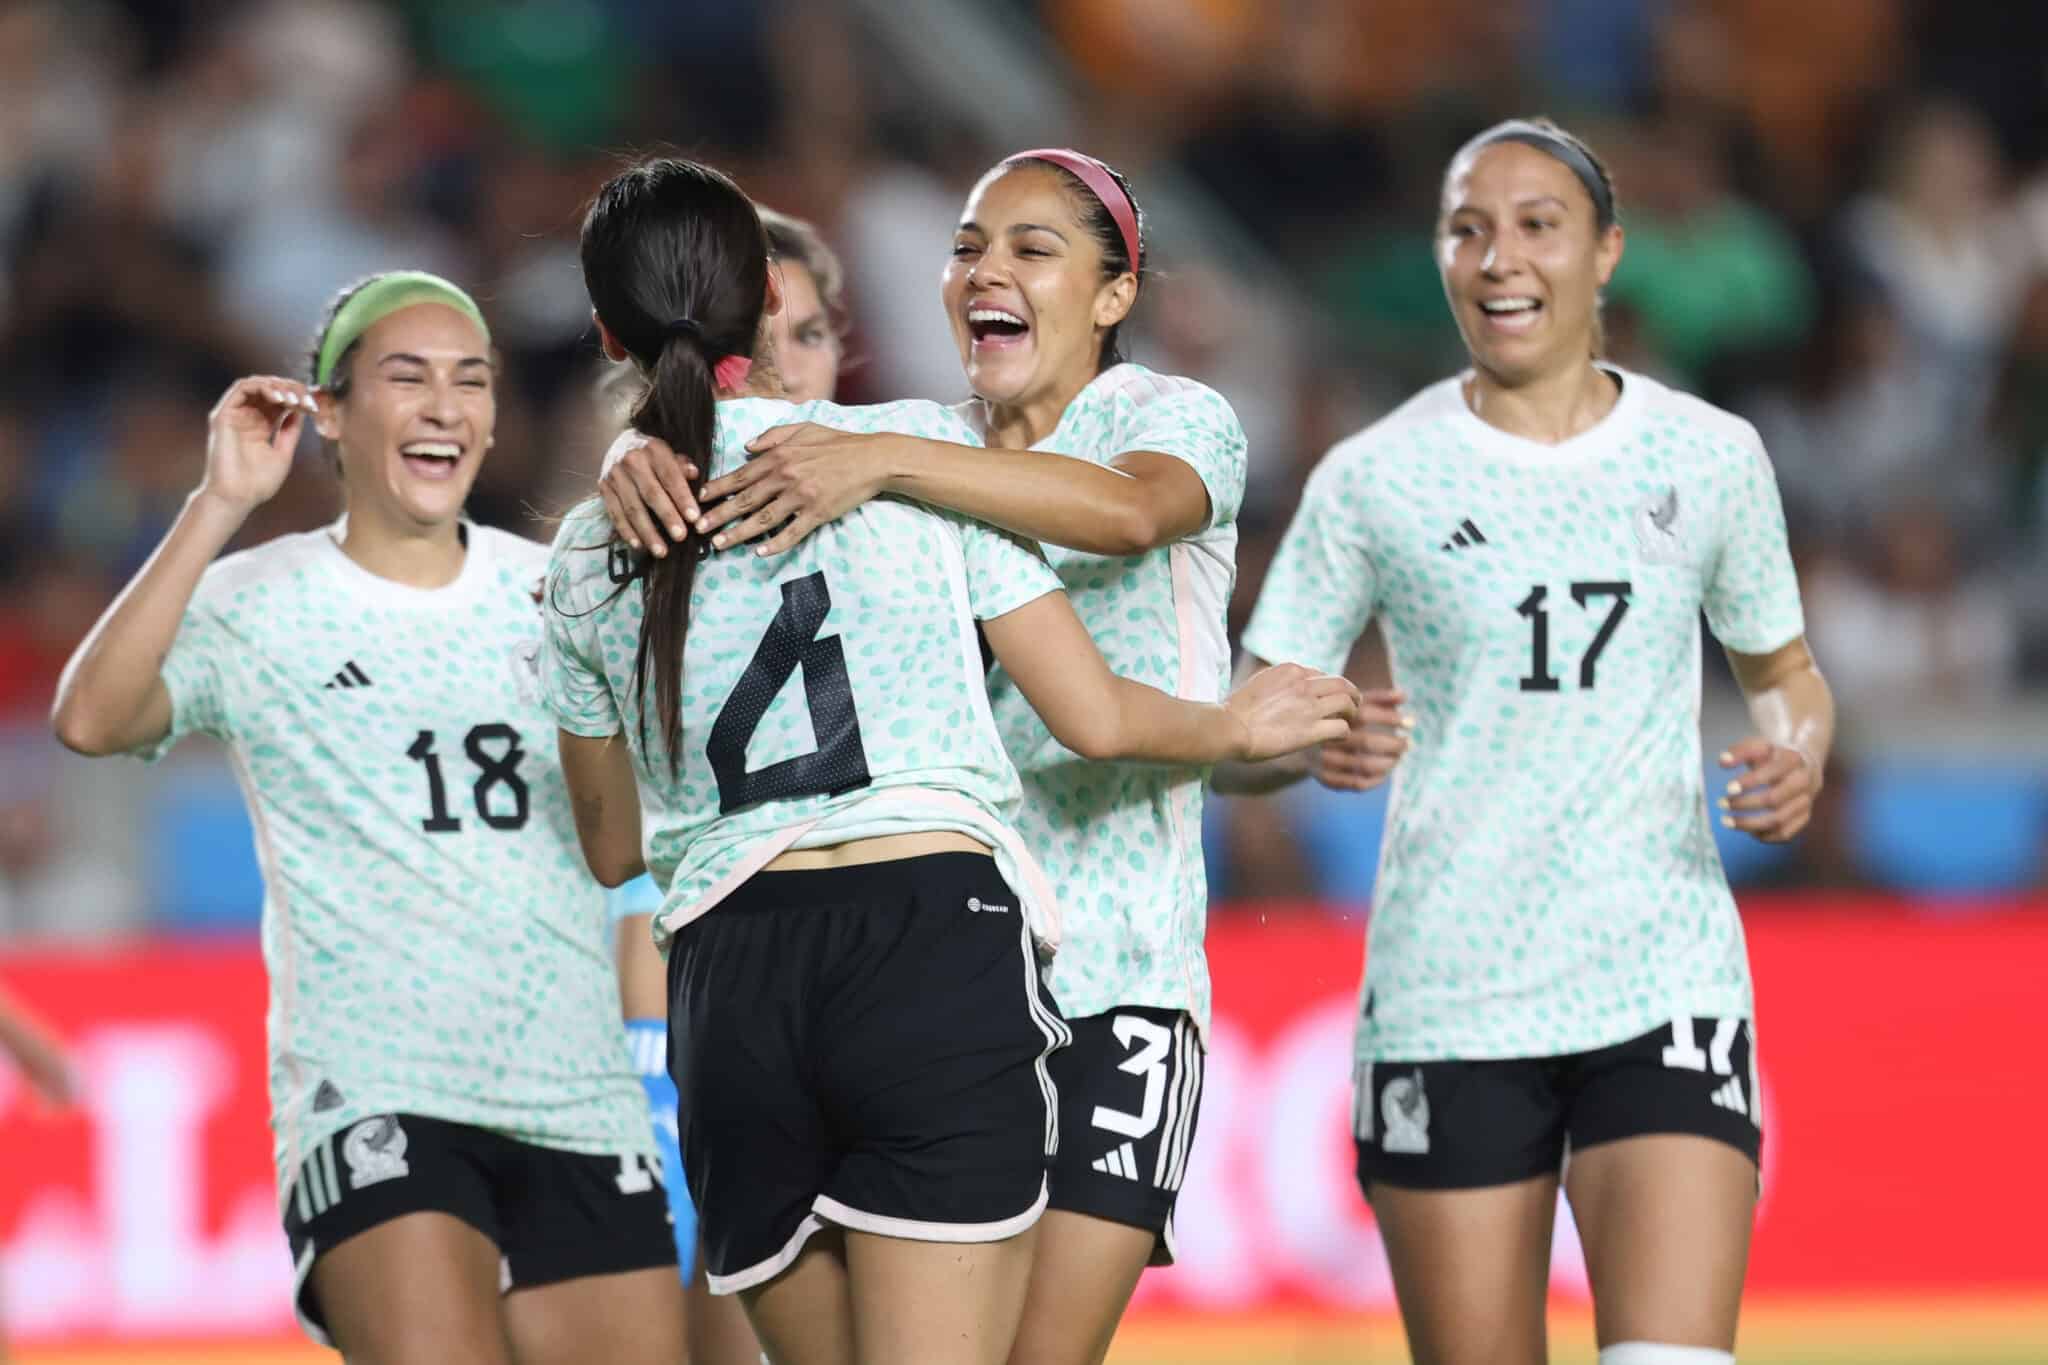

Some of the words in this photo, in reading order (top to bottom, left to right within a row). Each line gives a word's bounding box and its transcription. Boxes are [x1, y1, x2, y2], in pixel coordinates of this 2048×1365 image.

[1516, 581, 1632, 691] 17
[406, 723, 530, 832] 18
[1091, 1015, 1172, 1139] 3
